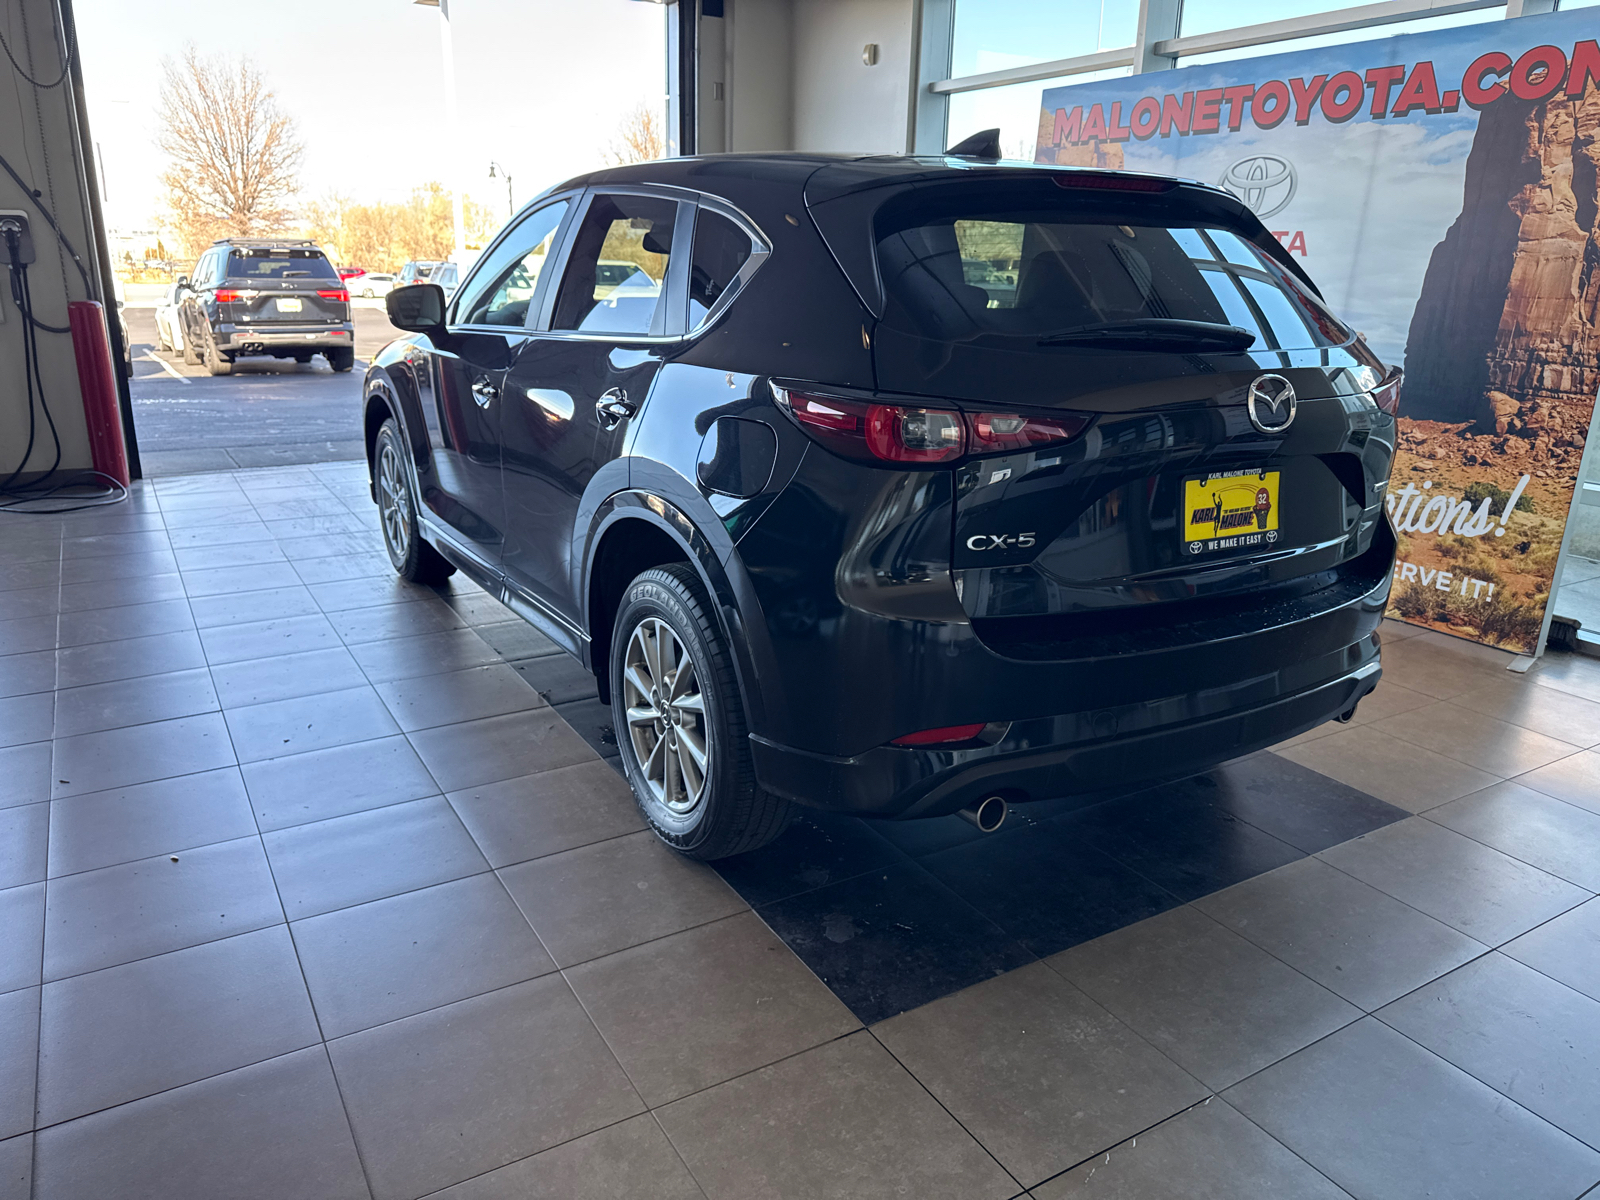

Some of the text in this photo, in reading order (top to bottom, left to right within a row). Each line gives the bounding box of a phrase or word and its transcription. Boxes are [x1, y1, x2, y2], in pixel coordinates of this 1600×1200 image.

[1258, 493, 1267, 504] 32
[1387, 474, 1531, 538] tions!
[1190, 508, 1216, 525] KARL
[1219, 512, 1254, 530] MALONE
[966, 531, 1036, 551] CX-5
[1208, 535, 1262, 550] WE MAKE IT EASY
[1460, 577, 1496, 603] IT!
